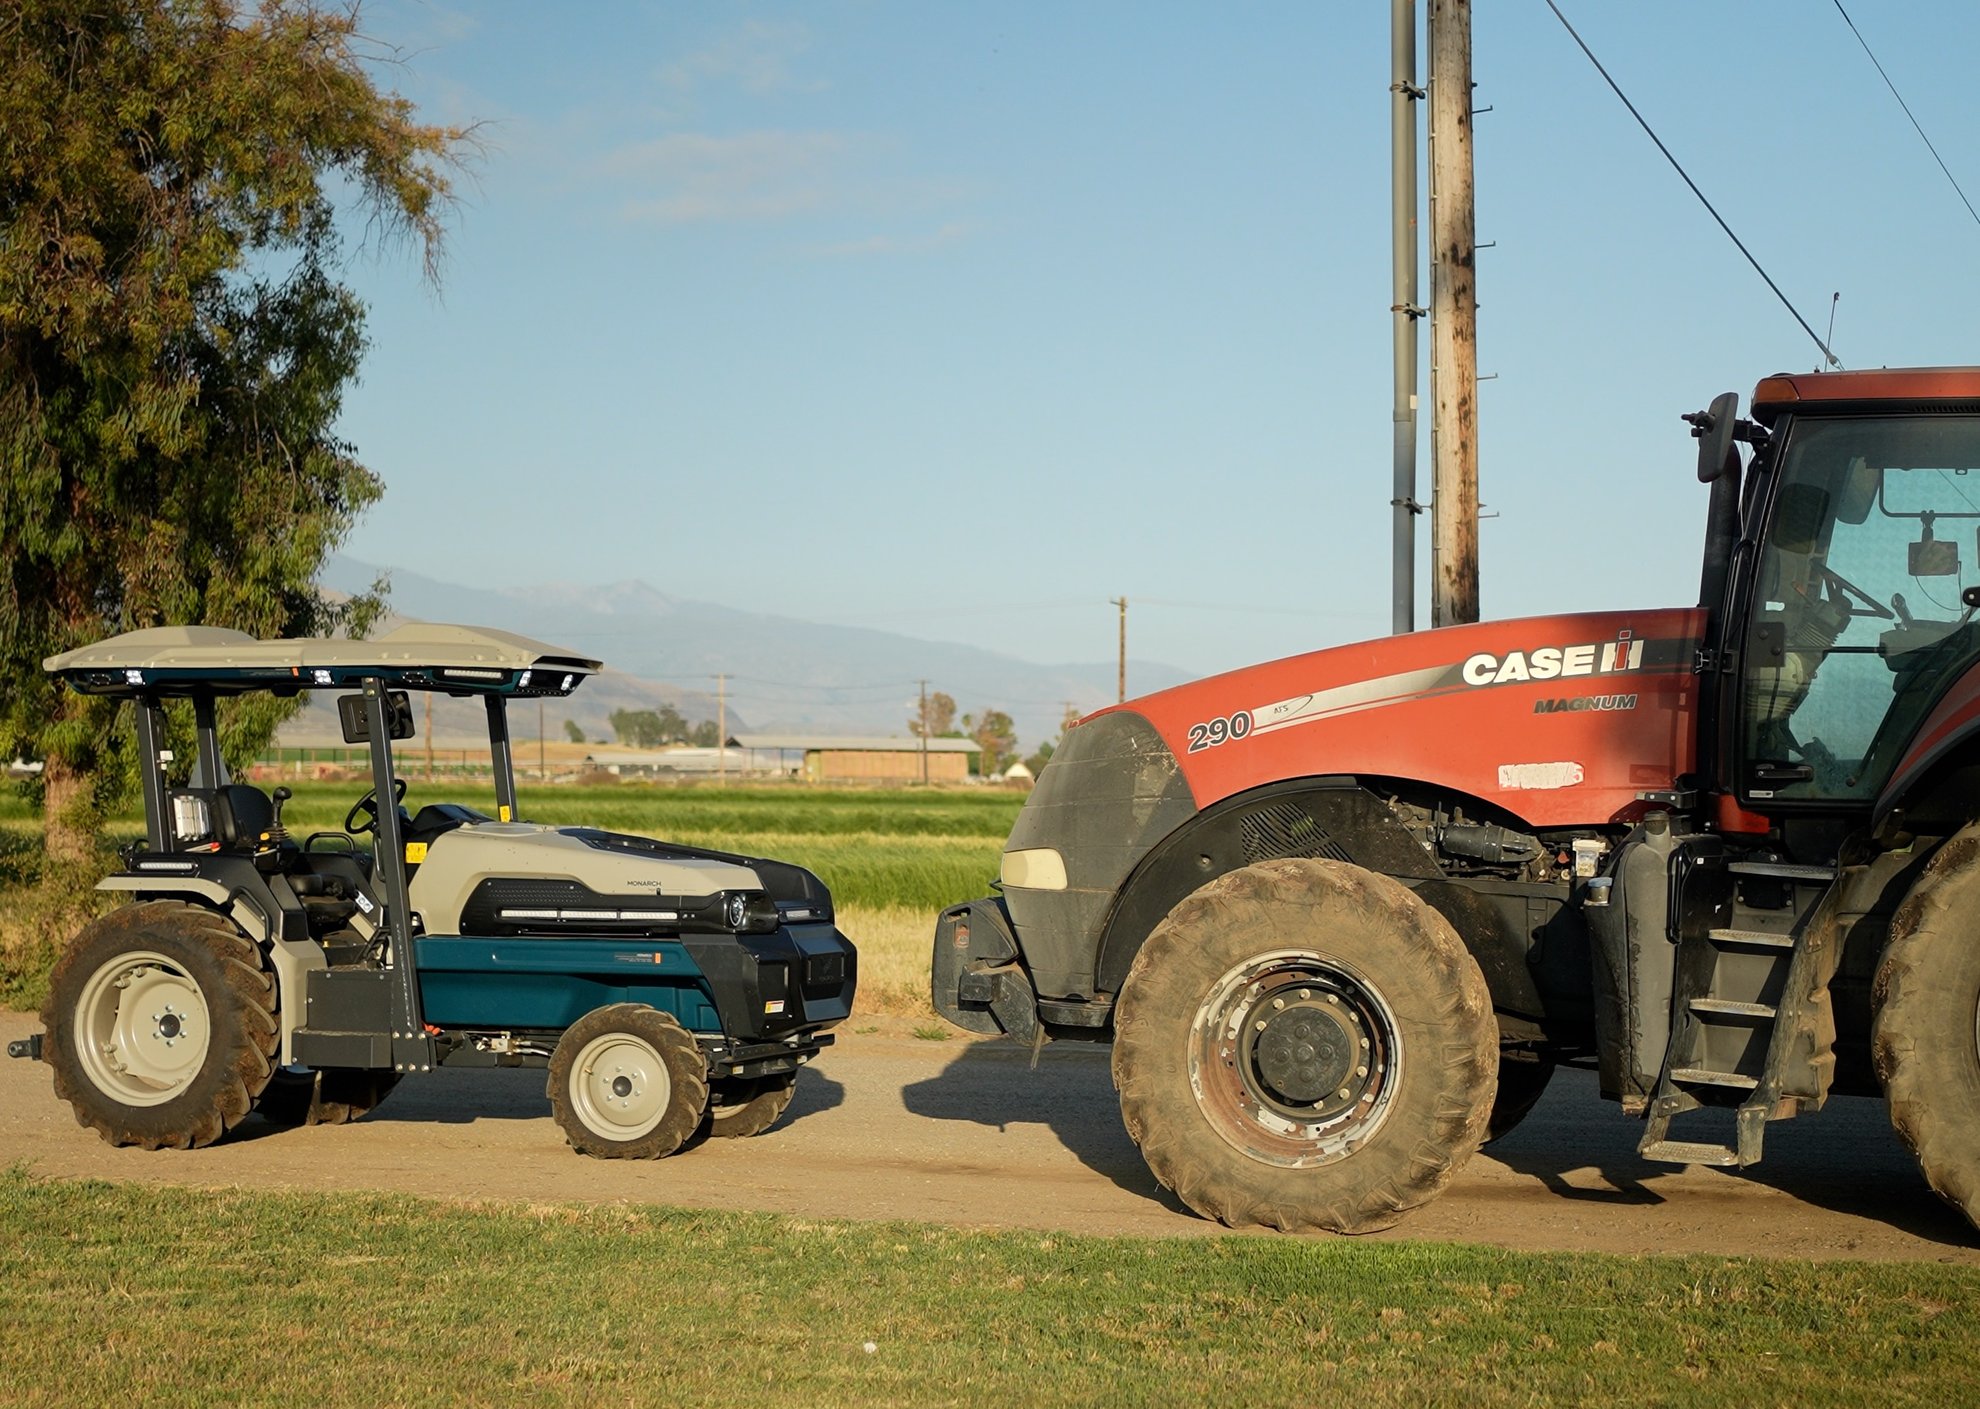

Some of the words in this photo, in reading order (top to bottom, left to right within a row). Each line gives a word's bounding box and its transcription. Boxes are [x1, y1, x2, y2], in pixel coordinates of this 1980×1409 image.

[1462, 644, 1596, 686] CASE
[1533, 694, 1638, 715] MAGNUM
[1187, 710, 1252, 754] 290
